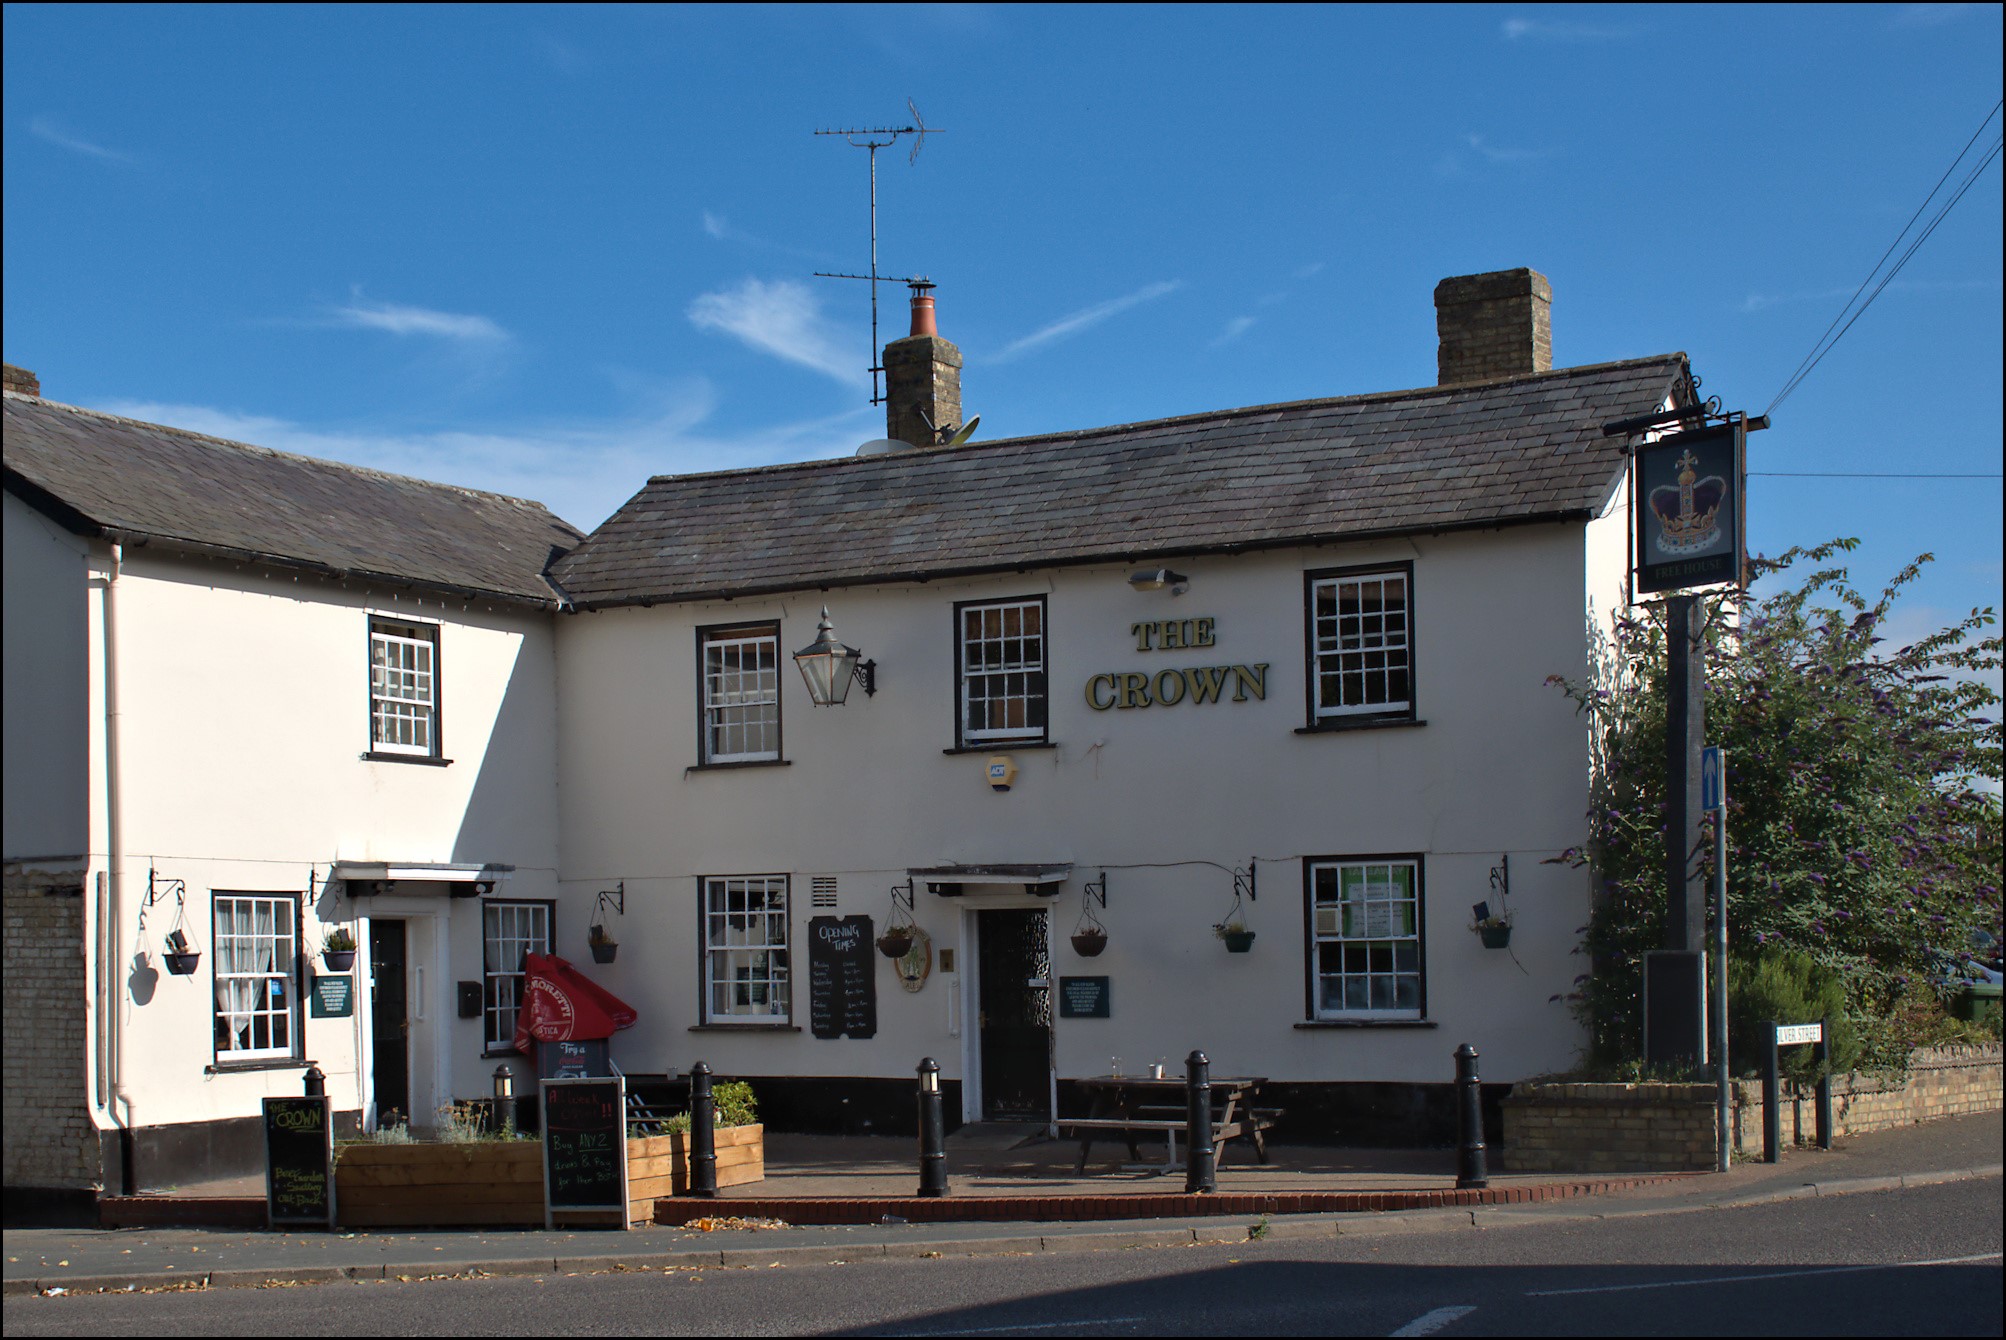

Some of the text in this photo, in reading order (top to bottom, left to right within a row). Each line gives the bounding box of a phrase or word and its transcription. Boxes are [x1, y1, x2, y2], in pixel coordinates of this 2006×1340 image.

[1655, 558, 1722, 579] FREE HOUSE
[1131, 616, 1216, 652] THE
[1085, 663, 1270, 711] CROWN
[819, 924, 860, 942] OPENING
[832, 939, 856, 951] TIMES
[531, 980, 571, 1017] MORETTI
[1778, 1026, 1820, 1042] ILVER STREET
[560, 1042, 578, 1056] Try
[276, 1108, 321, 1127] CROWN
[553, 1135, 573, 1155] Buy
[598, 1133, 608, 1147] 2
